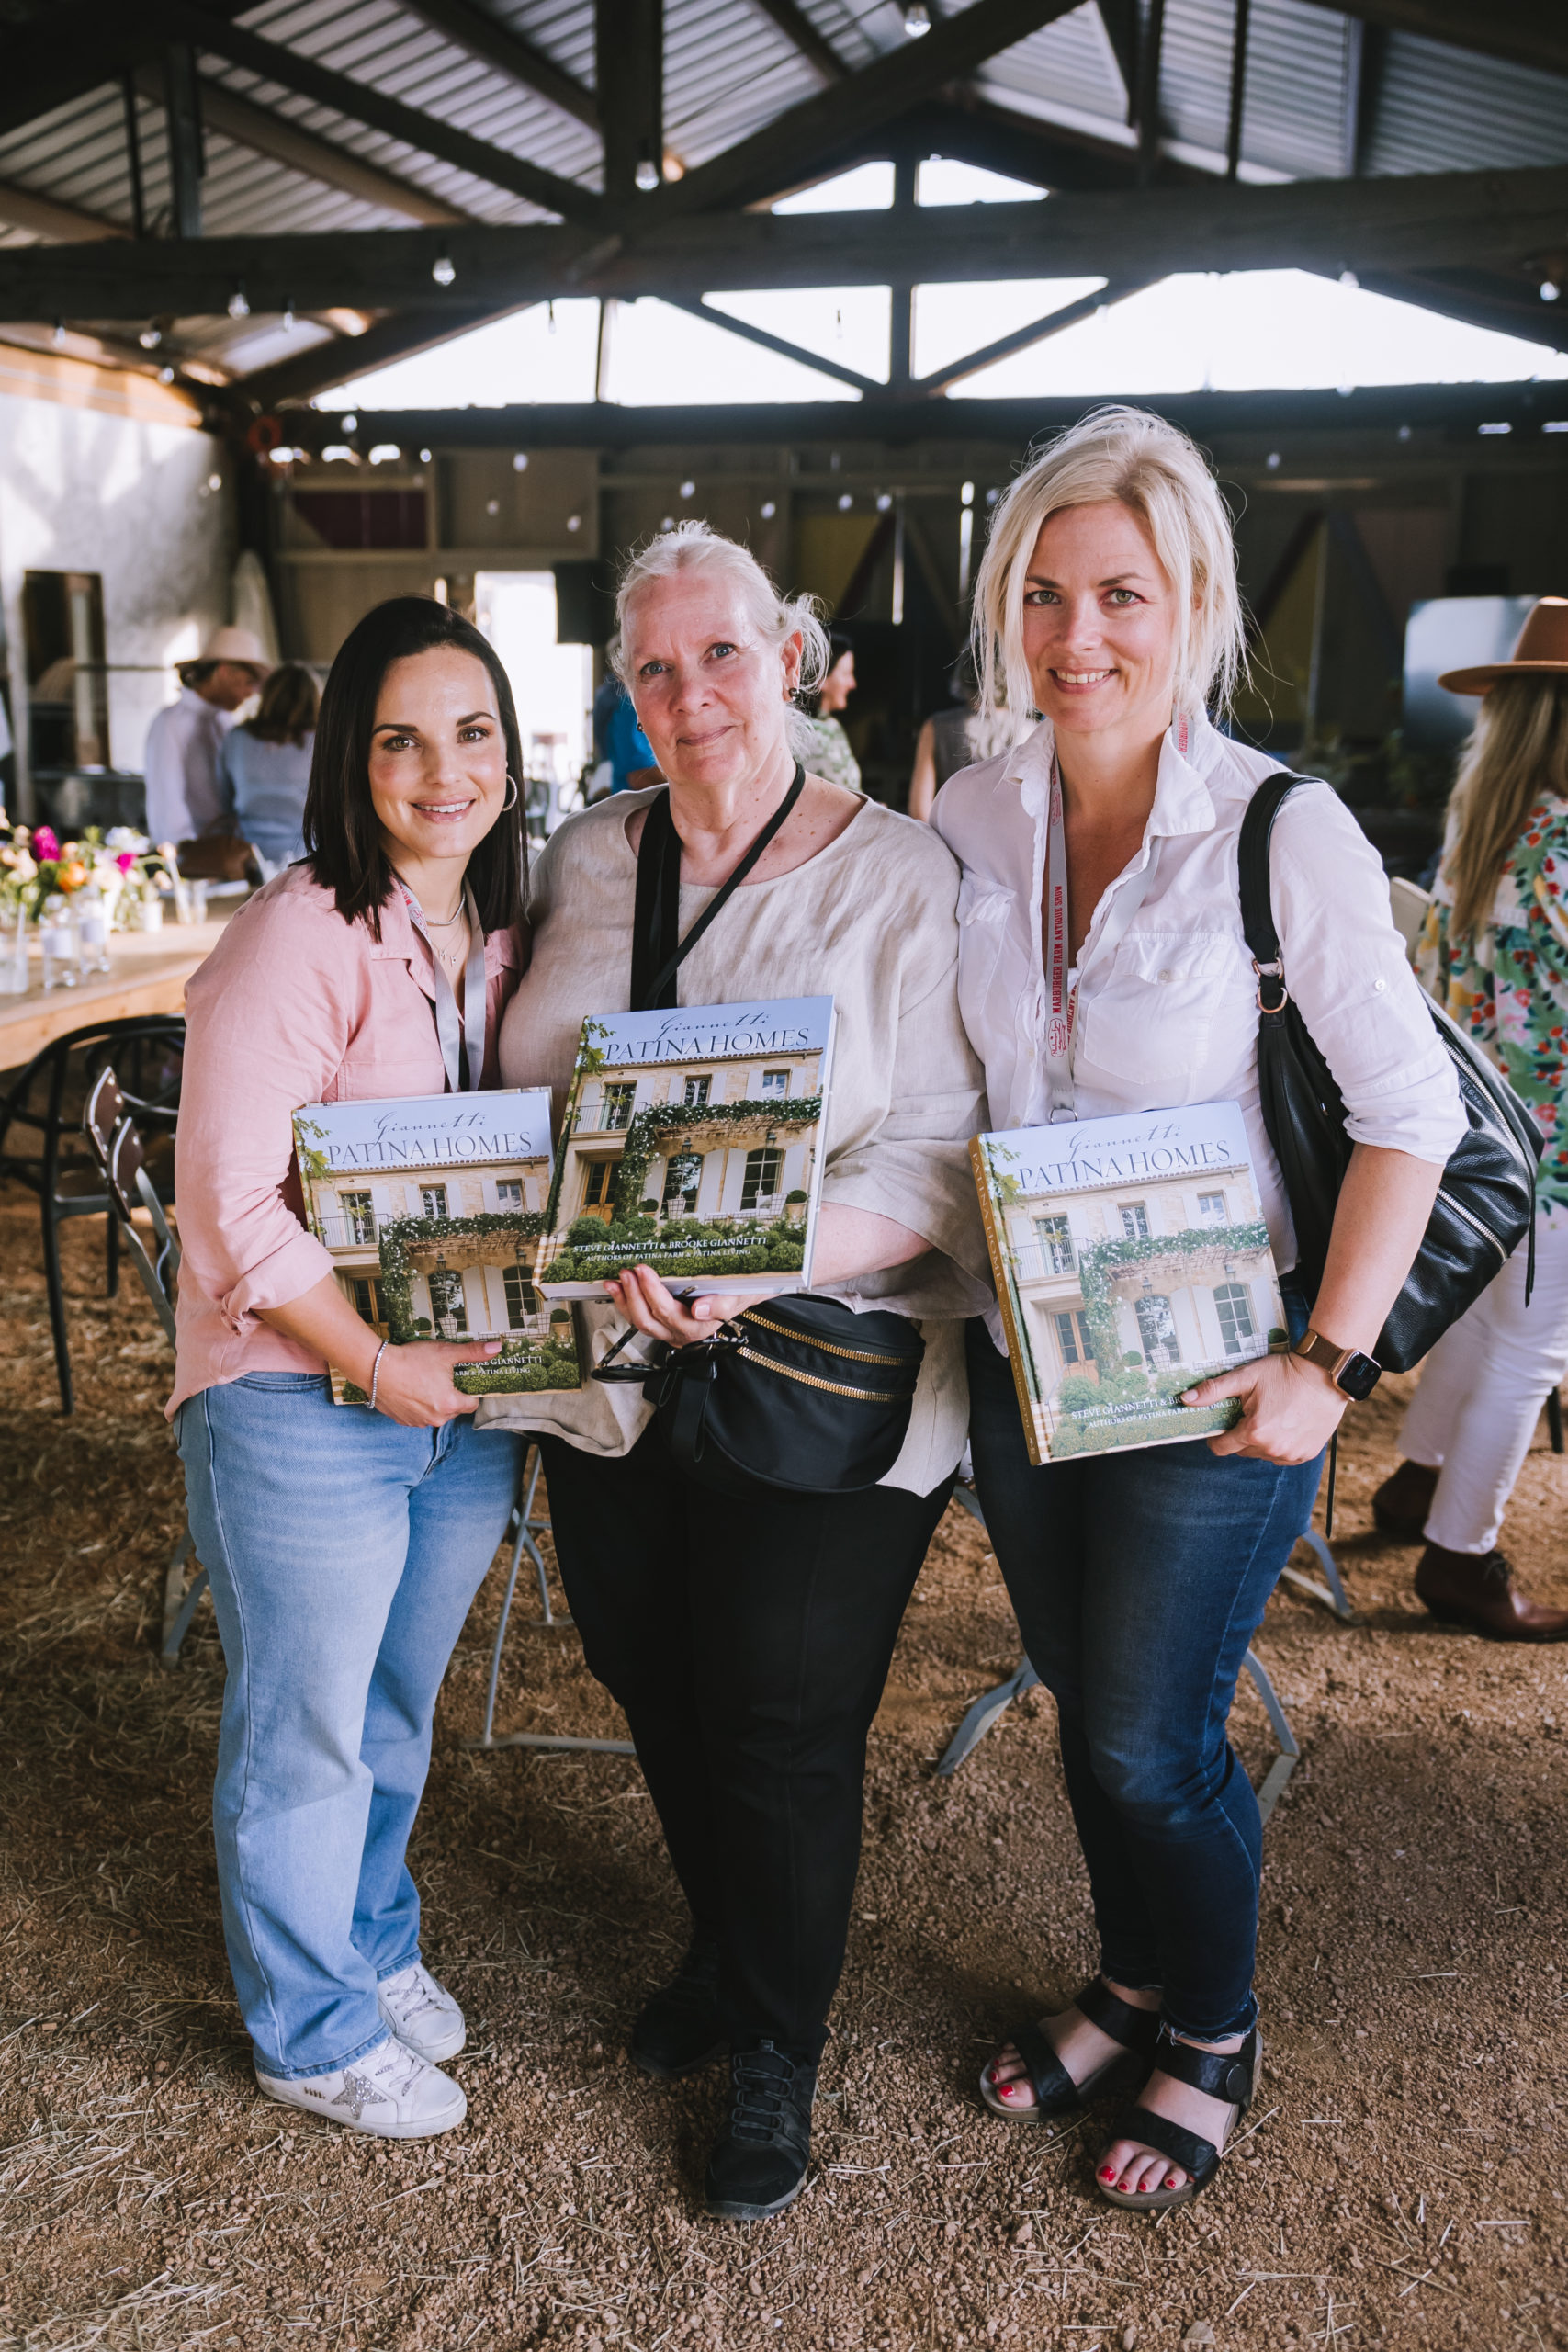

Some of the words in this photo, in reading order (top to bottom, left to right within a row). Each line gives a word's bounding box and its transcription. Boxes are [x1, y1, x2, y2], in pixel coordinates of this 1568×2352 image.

[1054, 886, 1063, 906] SHOW
[1054, 907, 1063, 941] ANTIQUE
[1053, 943, 1063, 964] FARM
[1052, 966, 1062, 1014] MARBURGER
[605, 1035, 703, 1061] PATINA
[705, 1027, 810, 1053] HOMES
[659, 1012, 772, 1044] Giannetti
[374, 1110, 488, 1147] Giannetti
[328, 1138, 427, 1165] PATINA
[431, 1131, 533, 1158] HOMES
[1065, 1122, 1183, 1171] Giannetti
[1017, 1155, 1123, 1189] PATINA
[1127, 1139, 1231, 1173] HOMES
[573, 1243, 602, 1253] STEVE
[603, 1240, 659, 1251] GIANNETTI
[669, 1238, 708, 1250] BROOKE
[709, 1237, 767, 1247] GIANNETTI
[585, 1253, 622, 1262] AUTHORS
[722, 1249, 750, 1257] LIVING
[490, 1355, 542, 1365] GIANNETTI
[1071, 1408, 1100, 1420] STEVE
[1102, 1398, 1158, 1415] GIANNETTI
[1089, 1417, 1125, 1429] AUTHORS
[1138, 1411, 1167, 1421] PATINA
[1168, 1407, 1189, 1416] FARM
